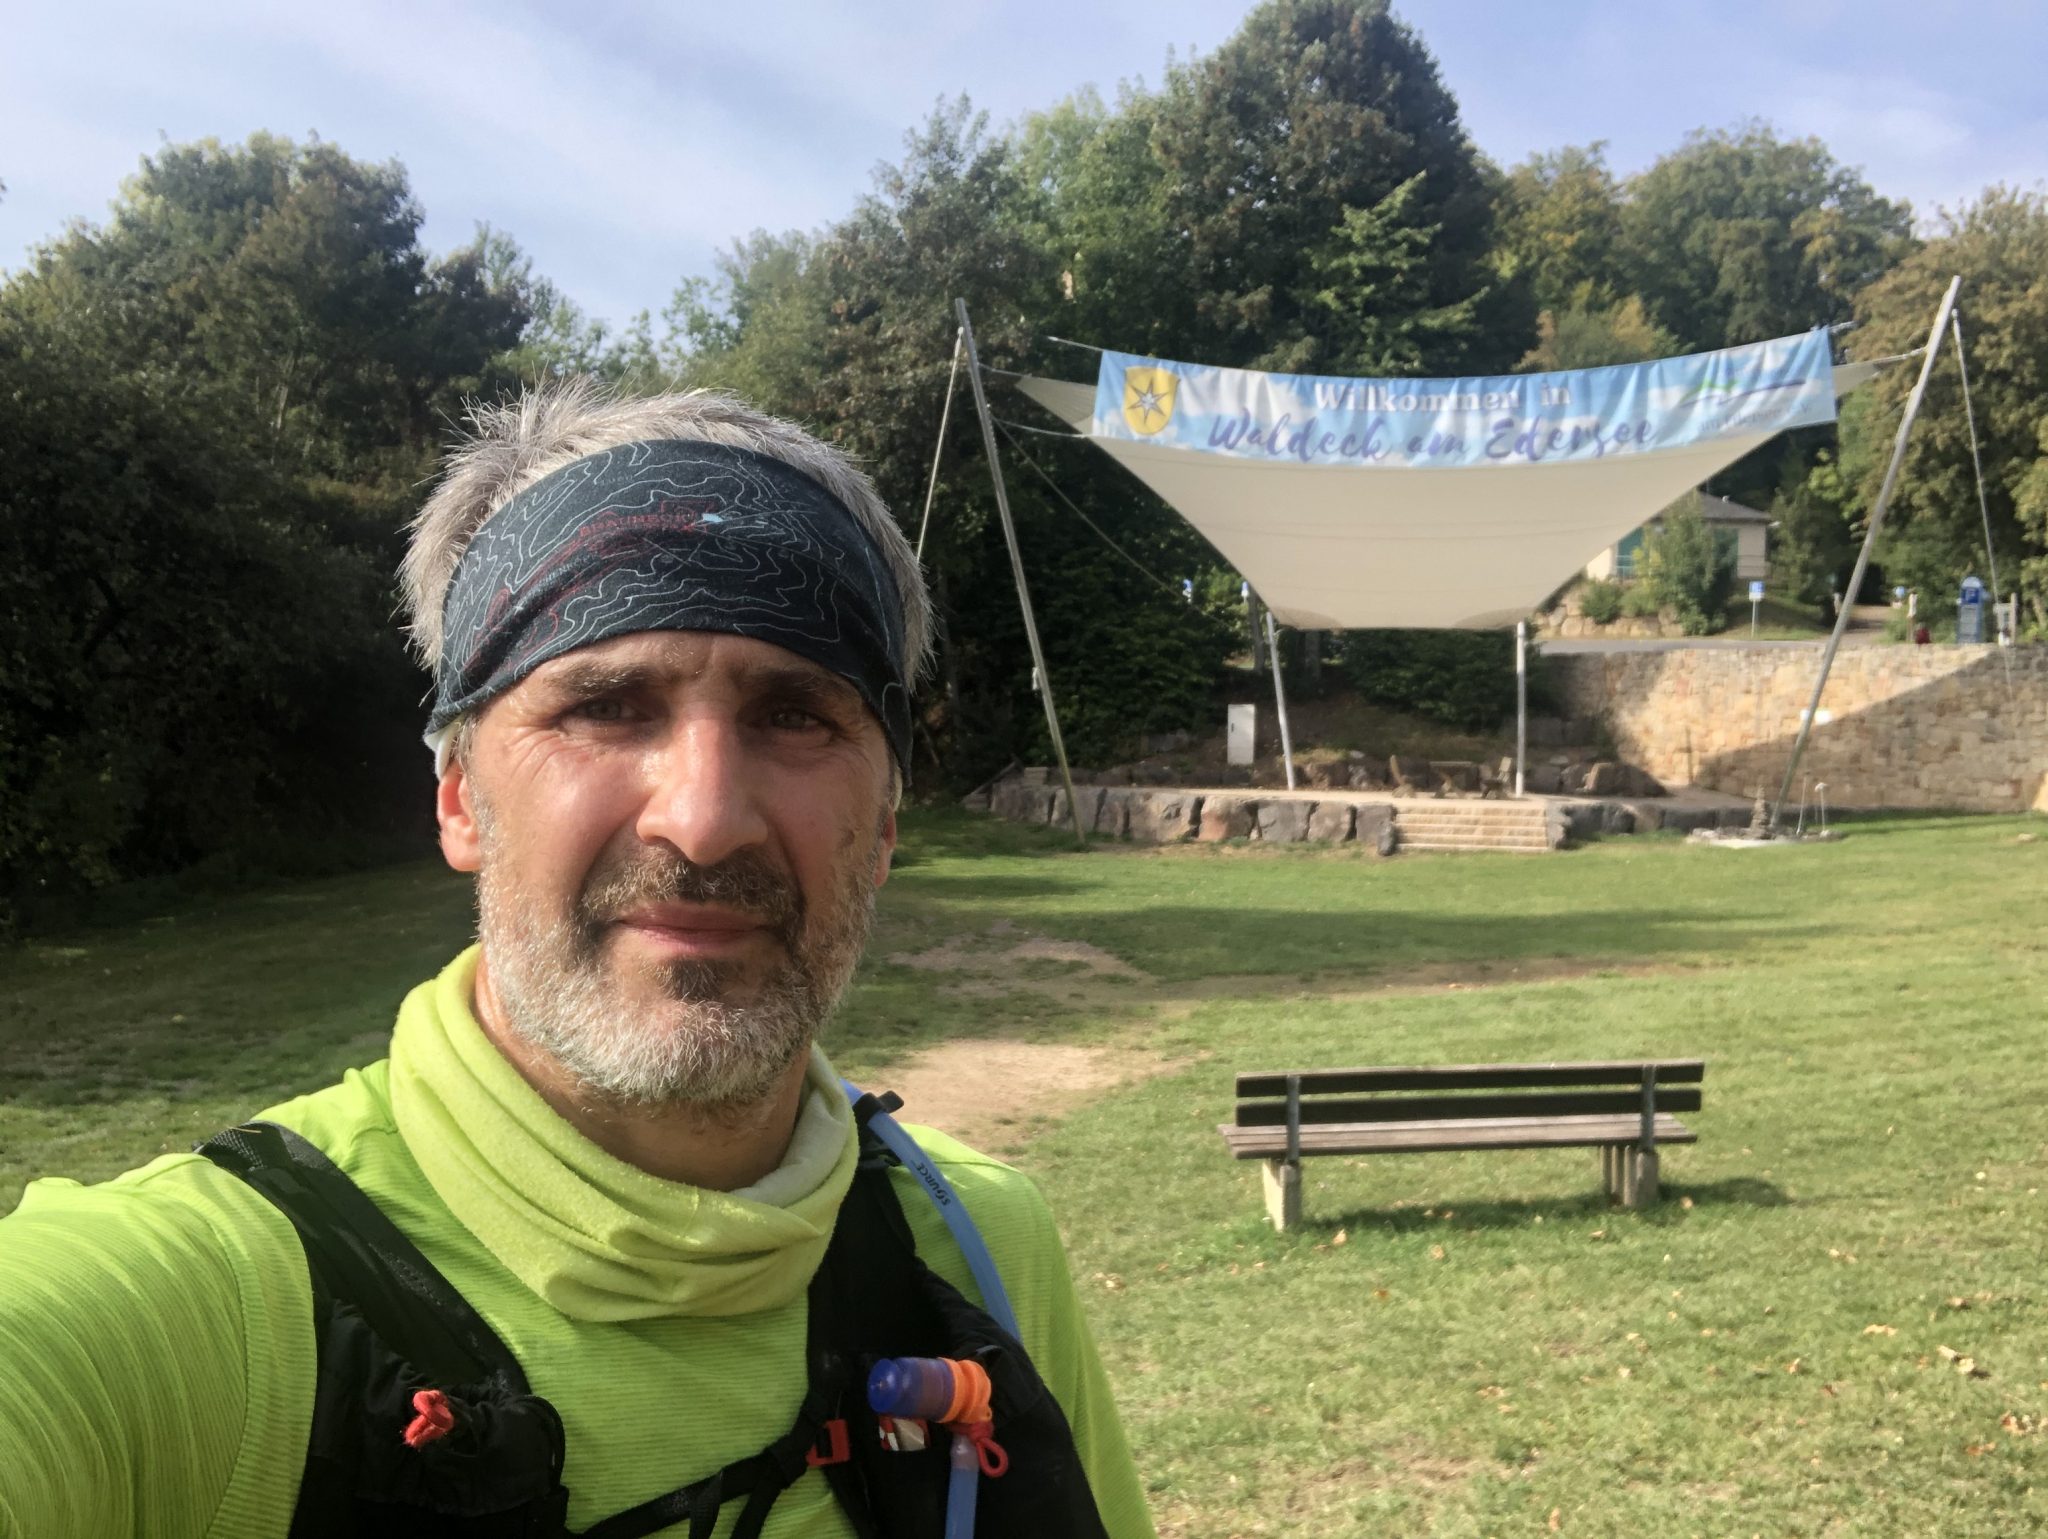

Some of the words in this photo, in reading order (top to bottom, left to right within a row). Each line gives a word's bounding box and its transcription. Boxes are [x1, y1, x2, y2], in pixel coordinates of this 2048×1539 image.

[1314, 382, 1520, 412] Willkommen
[1541, 382, 1571, 406] in
[1209, 408, 1391, 462] Waldeck
[1407, 429, 1470, 457] am
[1484, 415, 1659, 462] Edersee
[914, 1162, 951, 1206] SOURCE
